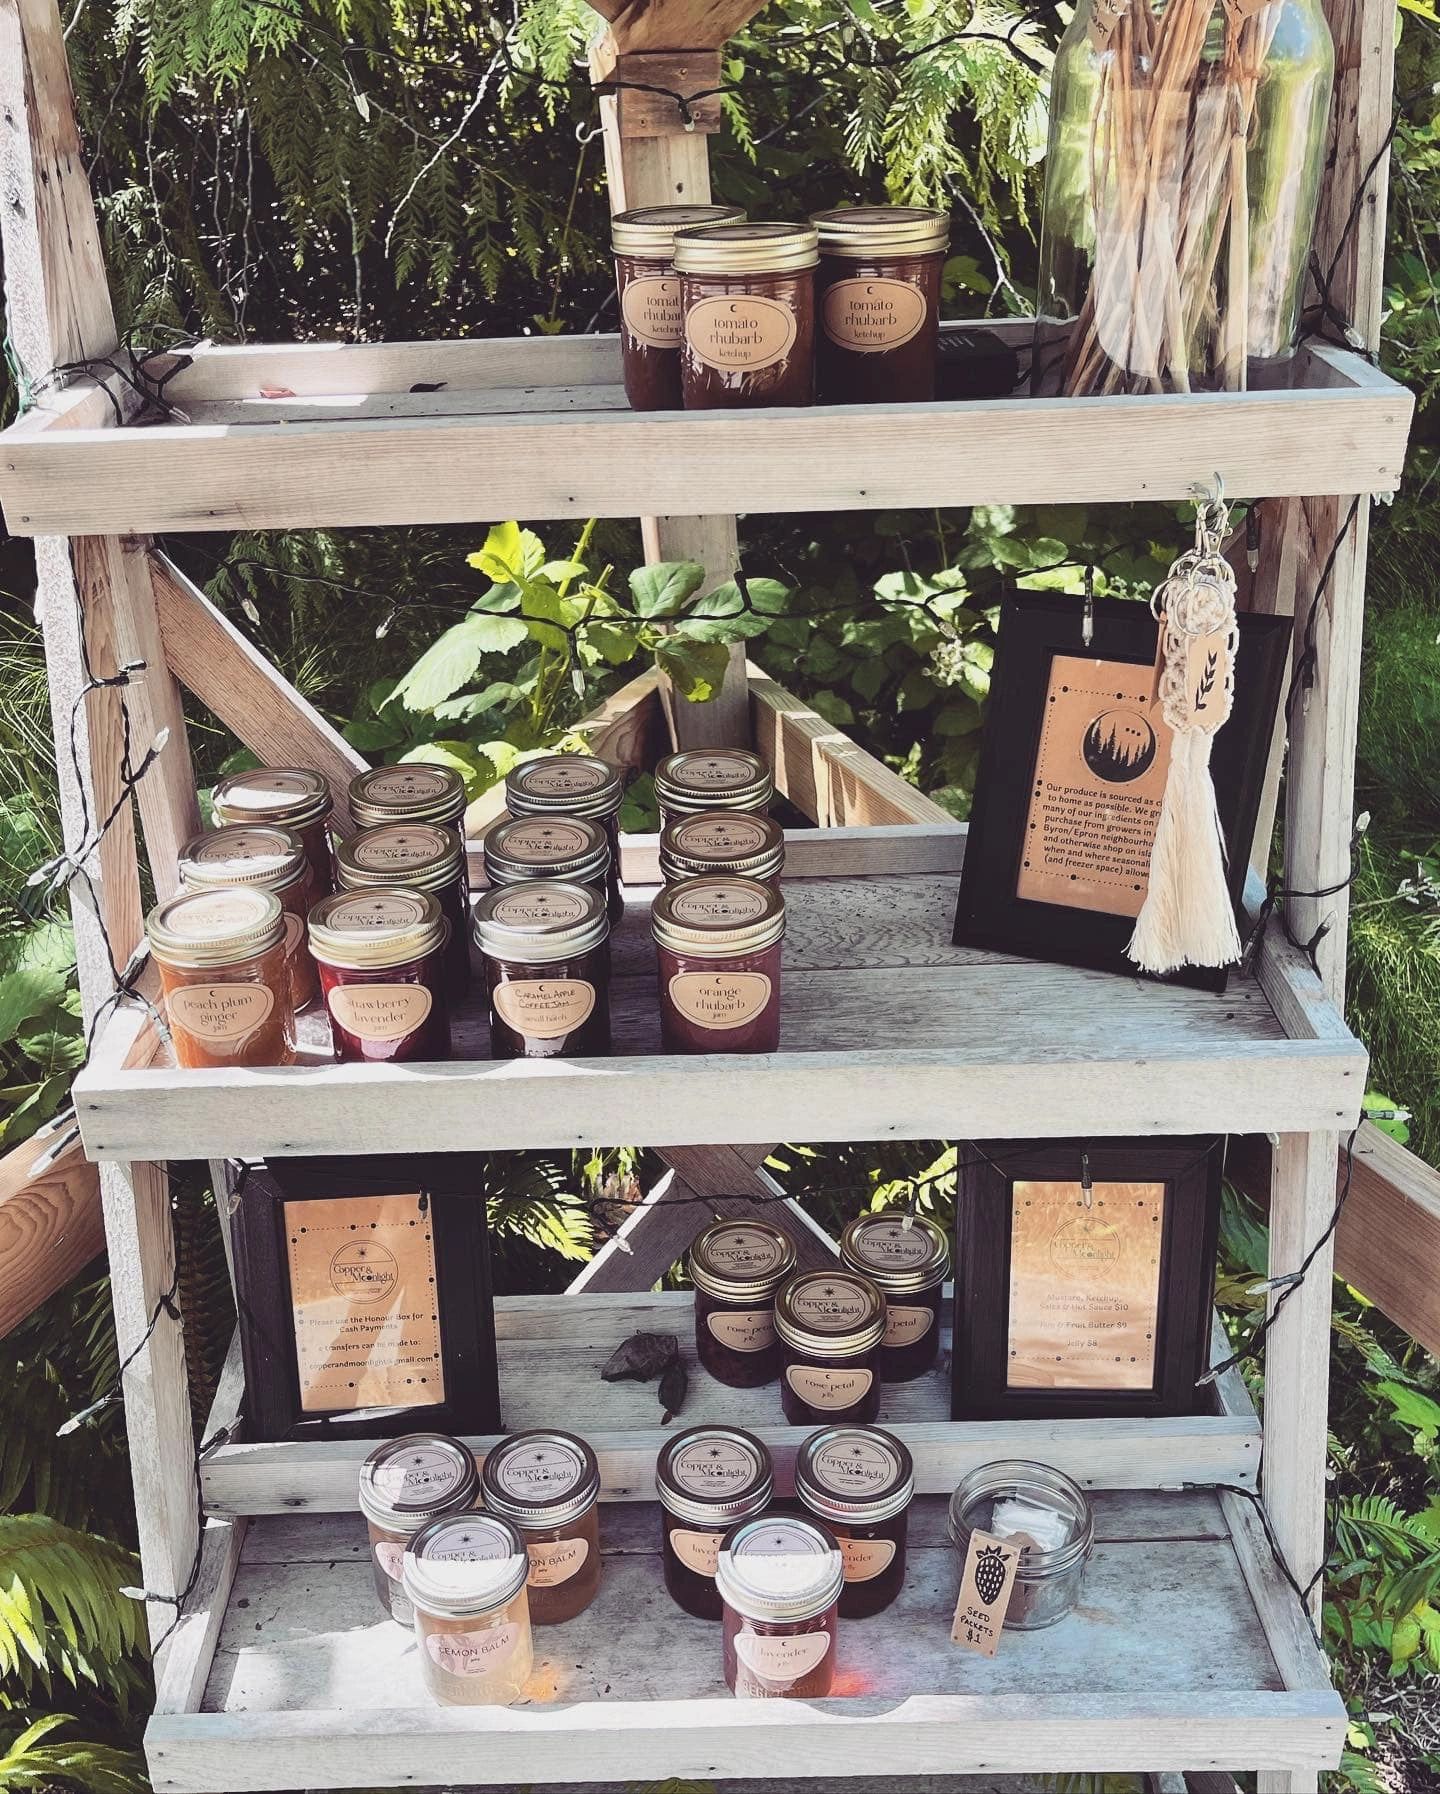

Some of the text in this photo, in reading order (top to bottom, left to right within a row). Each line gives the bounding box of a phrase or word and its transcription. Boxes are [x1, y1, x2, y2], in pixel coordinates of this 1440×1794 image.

[647, 296, 680, 307] tomat
[849, 300, 894, 311] tomato
[643, 308, 681, 321] rhubar
[845, 313, 897, 326] rhubarb
[714, 318, 759, 329] tomato
[710, 331, 763, 345] rhubarb
[854, 329, 886, 340] ketchup
[719, 349, 751, 360] ketchup
[1046, 783, 1062, 792] Our
[1064, 786, 1098, 798] produce
[1099, 790, 1107, 799] is
[1109, 793, 1142, 804] sourced
[1144, 798, 1154, 806] as
[1048, 794, 1057, 802] to
[1058, 794, 1082, 806] home
[1083, 799, 1093, 807] as
[1095, 801, 1132, 813] possible.
[1135, 806, 1148, 815] We
[1042, 803, 1065, 814] many
[1067, 806, 1077, 816] of
[1078, 810, 1092, 818] our
[1144, 819, 1154, 827] on
[1044, 815, 1152, 837] purchase from growers in
[1043, 834, 1058, 843] and
[1060, 837, 1101, 850] otherwise
[1102, 844, 1123, 854] shop
[1138, 849, 1151, 858] isla
[1100, 833, 1154, 847] neighbourho
[1043, 845, 1151, 868] when and where seasonali
[1044, 854, 1150, 878] (and freezer space) allow
[699, 987, 742, 1001] orange
[221, 996, 253, 1011] plum
[695, 999, 746, 1011] rhubarb
[200, 1011, 238, 1026] ginger
[354, 1011, 406, 1024] lavender
[334, 1264, 373, 1277] Copper &
[1114, 1303, 1129, 1311] $10
[412, 1313, 424, 1321] for
[893, 1319, 917, 1328] petal
[752, 1325, 773, 1336] peta
[1088, 1321, 1114, 1329] Butter
[830, 1380, 855, 1392] petal
[548, 1550, 577, 1566] BALM
[967, 1606, 990, 1623] SEED
[960, 1615, 994, 1637] PACKETS
[966, 1628, 981, 1645] $1
[481, 1636, 510, 1654] BALM
